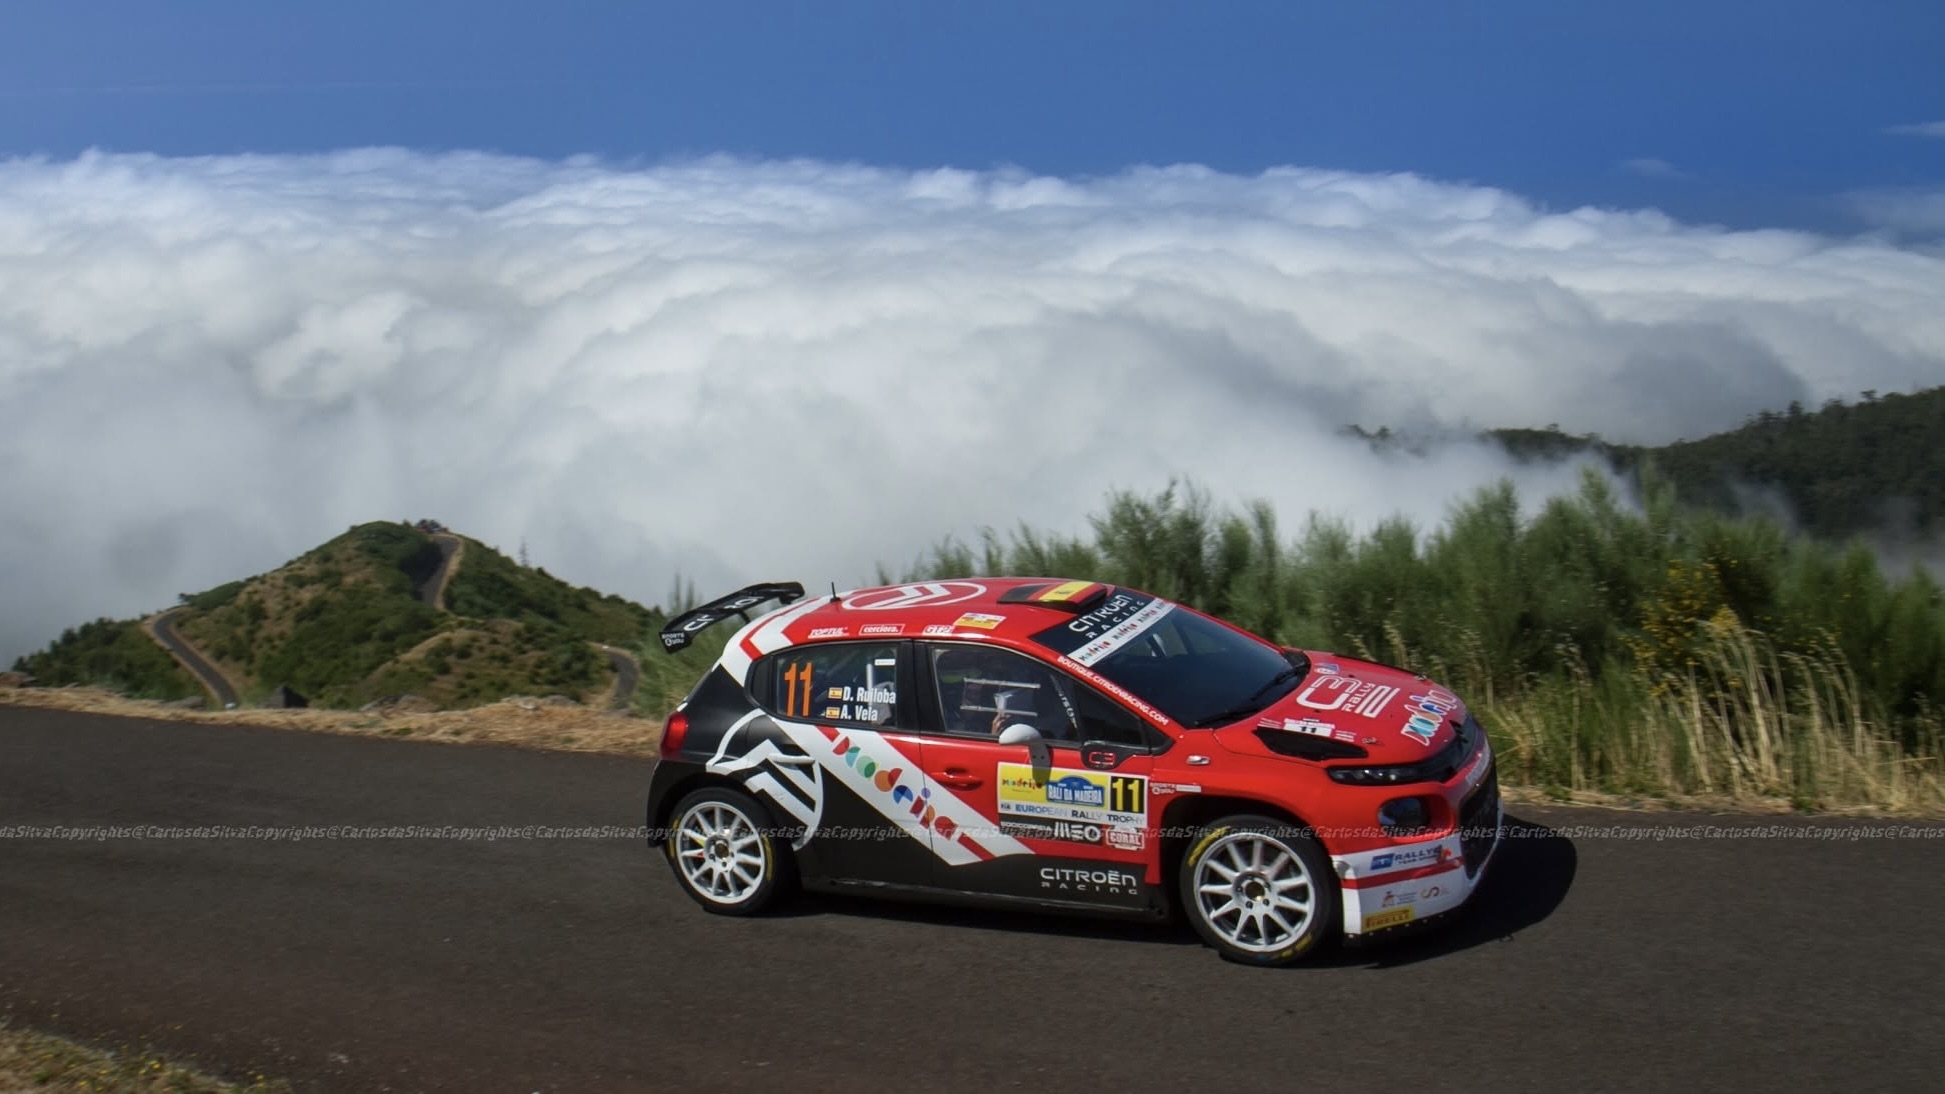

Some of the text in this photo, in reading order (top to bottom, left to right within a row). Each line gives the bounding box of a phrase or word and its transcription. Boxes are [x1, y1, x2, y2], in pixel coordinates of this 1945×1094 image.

[1085, 600, 1145, 639] RACING
[784, 662, 813, 717] 11
[842, 686, 897, 704] D. Ruiloba
[840, 704, 878, 721] A. Vela
[1112, 778, 1140, 813] 11
[1015, 804, 1144, 826] EUROPEAN RALLY TROPHY
[1040, 867, 1137, 887] CITROËN
[1041, 881, 1138, 896] RACING
